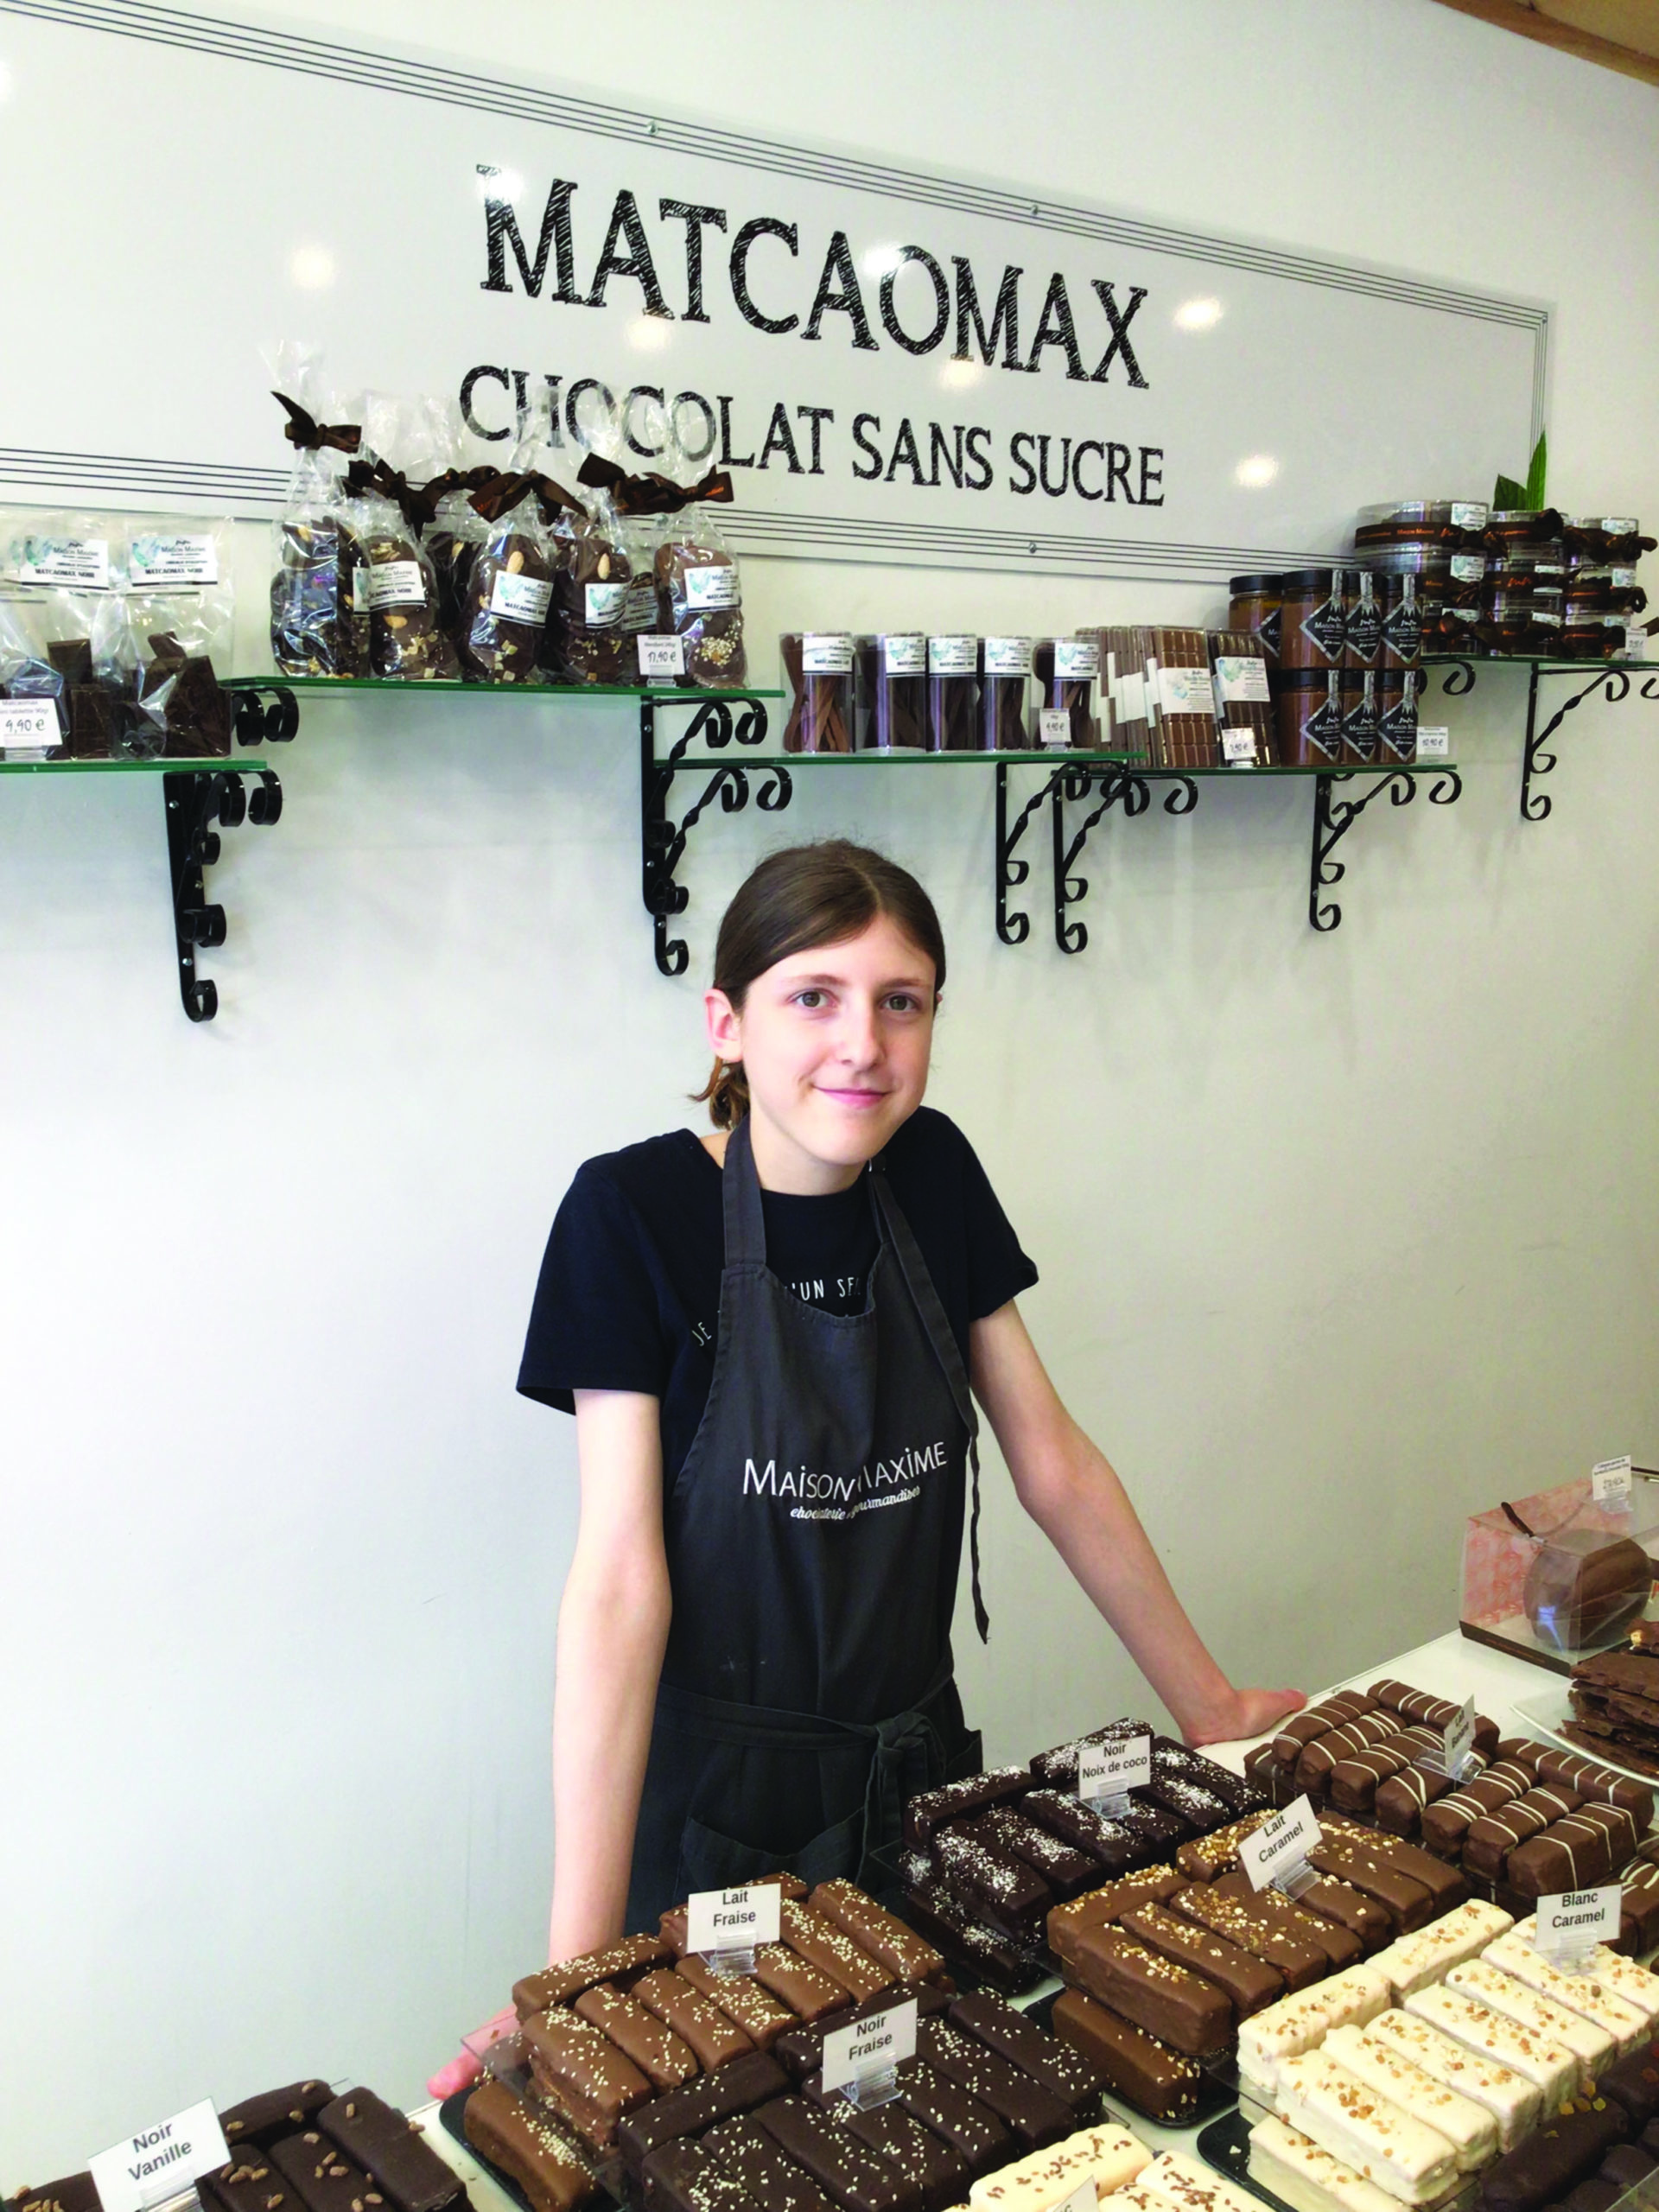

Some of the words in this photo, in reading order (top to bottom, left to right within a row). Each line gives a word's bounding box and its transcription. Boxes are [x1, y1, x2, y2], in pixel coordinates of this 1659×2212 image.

[476, 164, 1150, 389] MATCAOMAX
[460, 365, 835, 475] CHOCOLAT
[852, 411, 994, 491] SANS
[1009, 432, 1165, 507] SUCRE
[692, 1321, 712, 1347] JE
[785, 1279, 824, 1301] 'UN
[1103, 1744, 1127, 1758] Noir
[1082, 1766, 1105, 1779] Noix
[1108, 1760, 1121, 1773] de
[1122, 1756, 1147, 1770] coco
[1263, 1815, 1287, 1838] Lait
[1258, 1821, 1304, 1863] Caramel
[722, 1889, 748, 1906] Lait
[1561, 1892, 1599, 1908] Blanc
[713, 1910, 756, 1928] Fraise
[1552, 1907, 1605, 1929] Caramel
[856, 2015, 887, 2037] Noir
[849, 2033, 893, 2061] Fraise
[132, 2122, 172, 2153] Noir
[128, 2141, 192, 2181] Vanille
